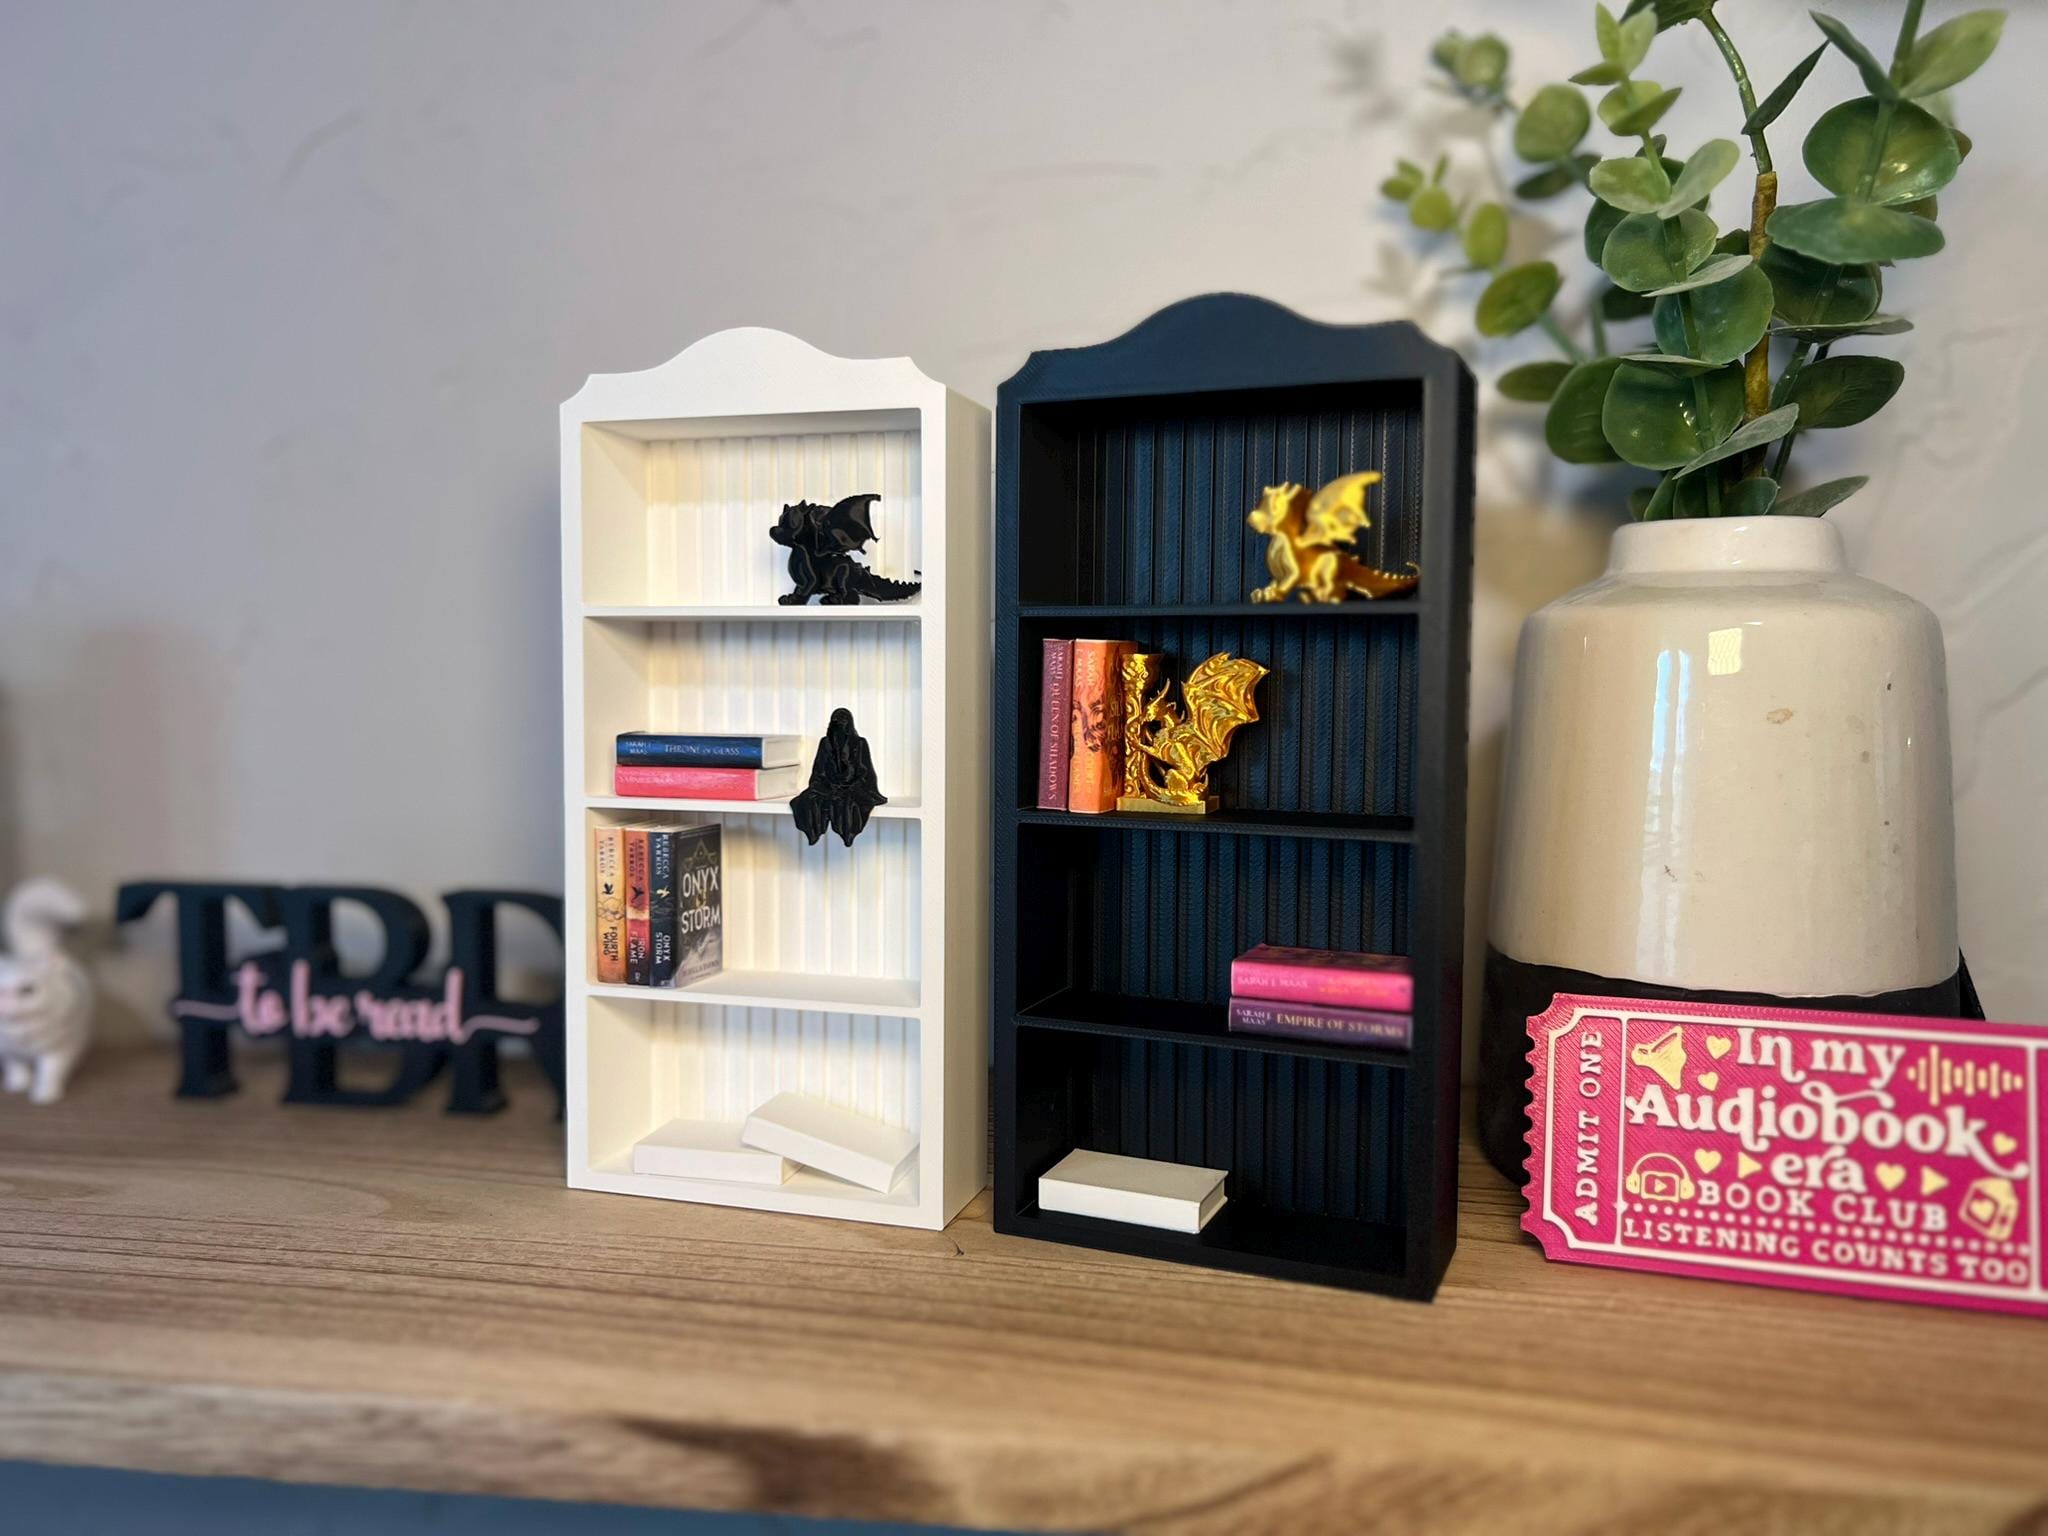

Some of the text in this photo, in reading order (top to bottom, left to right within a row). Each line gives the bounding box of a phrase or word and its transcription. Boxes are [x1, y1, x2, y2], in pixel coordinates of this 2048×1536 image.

[1075, 657, 1083, 688] MAAS
[1086, 650, 1095, 686] SARAH
[712, 746, 740, 756] GLASS
[1048, 683, 1061, 800] QUEEN OF SHADOWS
[655, 837, 663, 875] YARROS
[662, 834, 670, 879] REBECCA
[682, 865, 720, 898] ONYX
[681, 904, 721, 934] STORM
[603, 932, 611, 956] WING
[609, 926, 619, 962] FOURTH
[629, 931, 639, 964] FLAME
[637, 938, 645, 959] IRON
[655, 931, 663, 964] STORM
[663, 935, 671, 961] ONYX
[1238, 976, 1269, 987] SARAH
[1279, 979, 1309, 988] MAAS
[229, 958, 469, 1044] to be read
[1236, 1008, 1265, 1018] SARAH
[1242, 1017, 1266, 1026] MAAS
[1276, 1013, 1405, 1037] EMPIRE OF STORMS
[1736, 1027, 1907, 1089] In my
[1574, 1031, 1602, 1226] ADMIT ONE
[1625, 1081, 2029, 1179] Audiobook
[1770, 1146, 1867, 1193] era
[1697, 1179, 1948, 1231] BOOK CLUB
[1623, 1218, 2029, 1284] LISTENING COUNTS TOO
